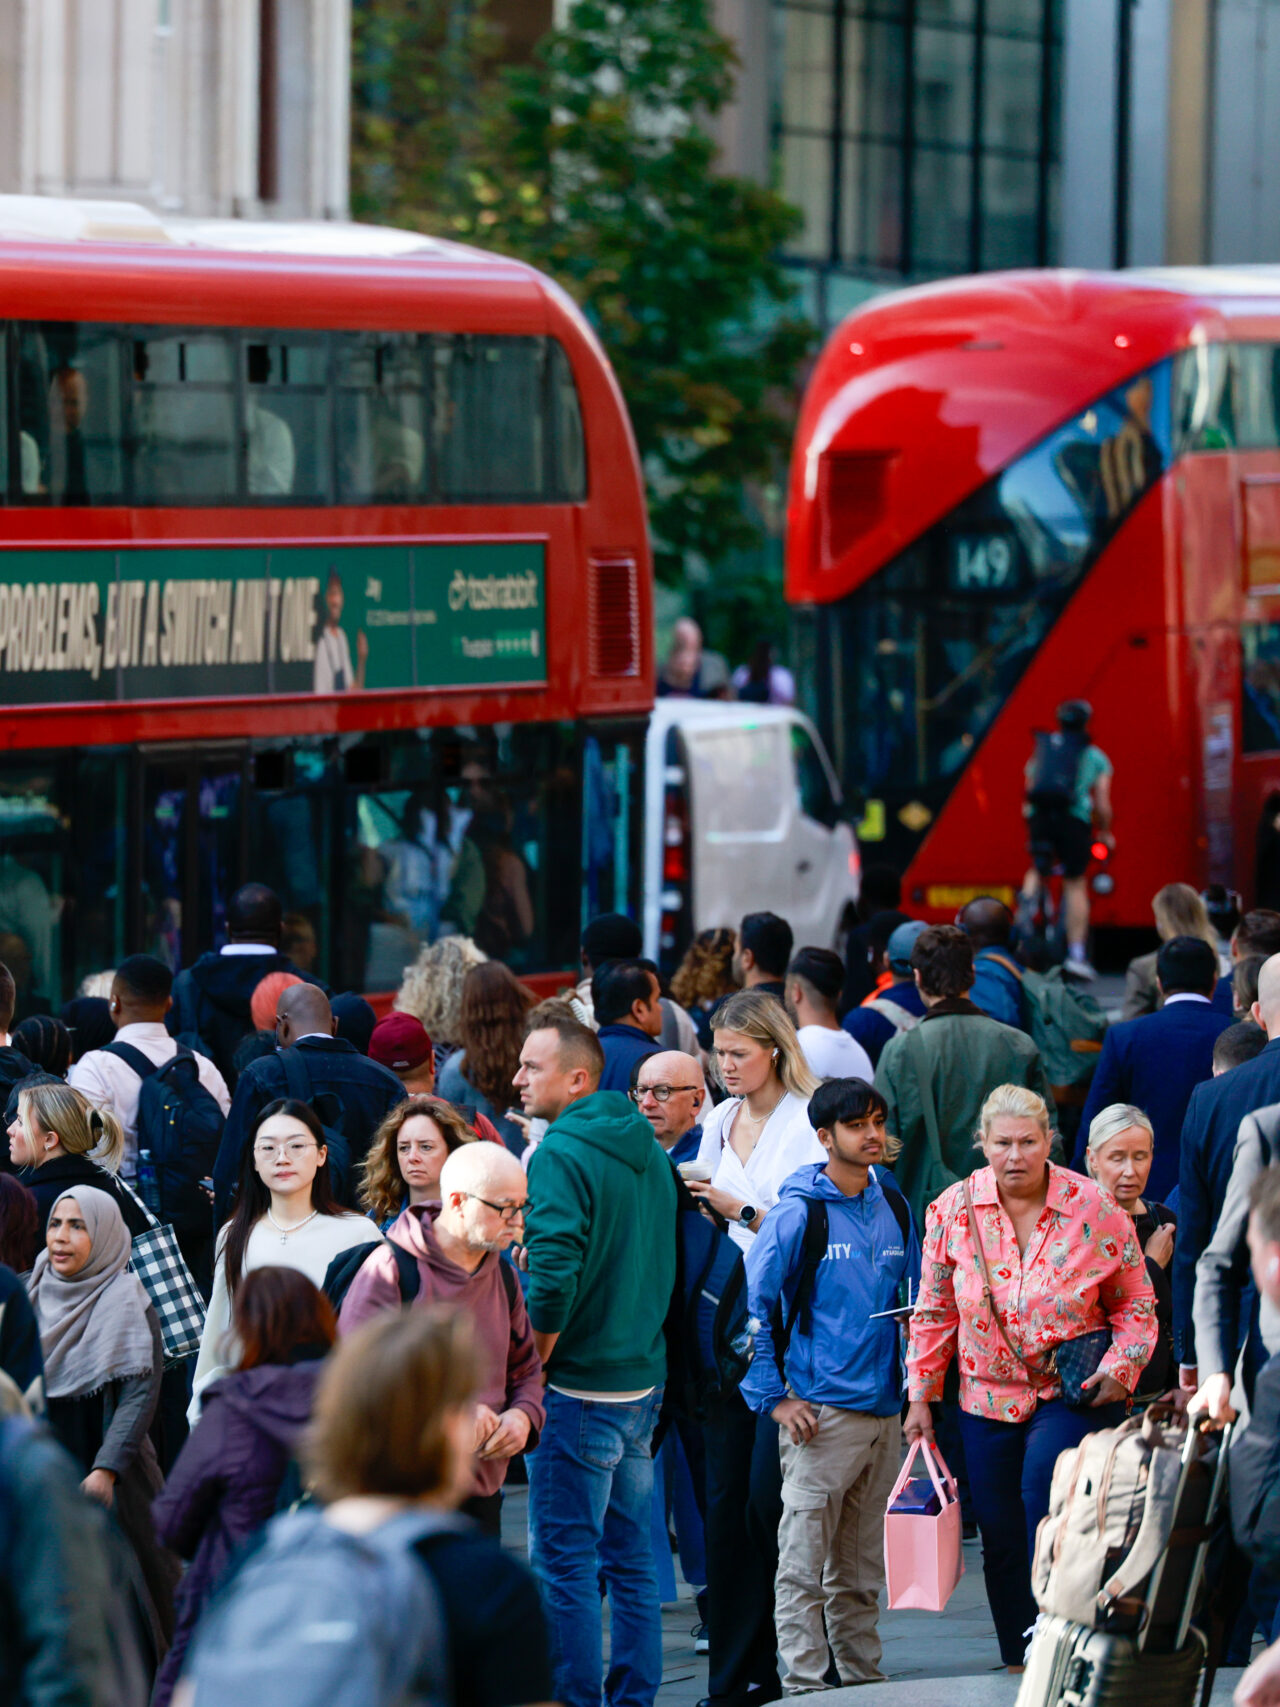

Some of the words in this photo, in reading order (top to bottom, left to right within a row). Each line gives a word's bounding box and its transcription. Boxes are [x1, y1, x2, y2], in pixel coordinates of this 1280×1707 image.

[958, 538, 1010, 587] 149
[103, 580, 146, 670] BUT
[142, 579, 160, 667] A
[821, 1243, 851, 1261] ITY
